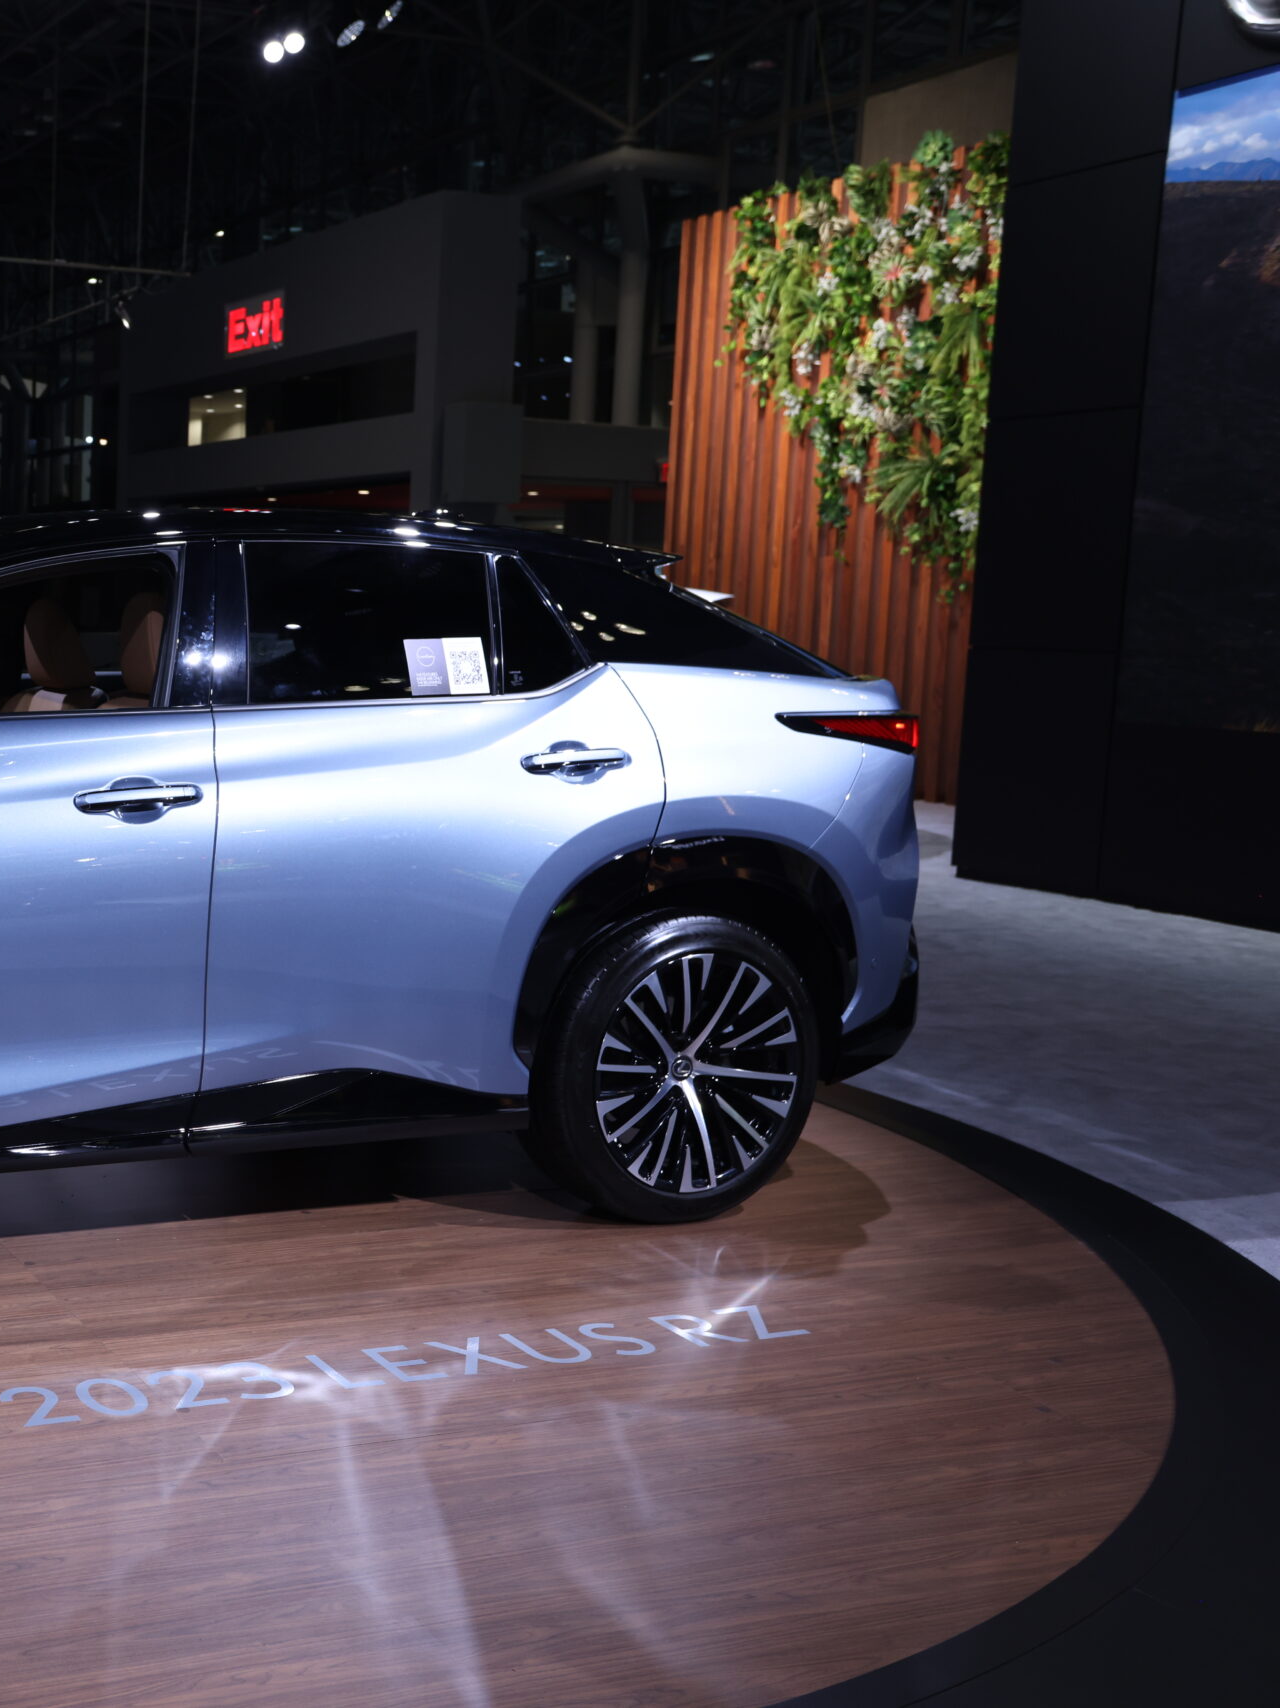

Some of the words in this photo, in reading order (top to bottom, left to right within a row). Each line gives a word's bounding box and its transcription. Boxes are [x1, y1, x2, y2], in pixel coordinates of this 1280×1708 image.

[228, 297, 284, 354] Exit
[0, 1362, 295, 1427] 2023
[305, 1323, 656, 1389] LEXUS
[648, 1305, 811, 1347] RZ
